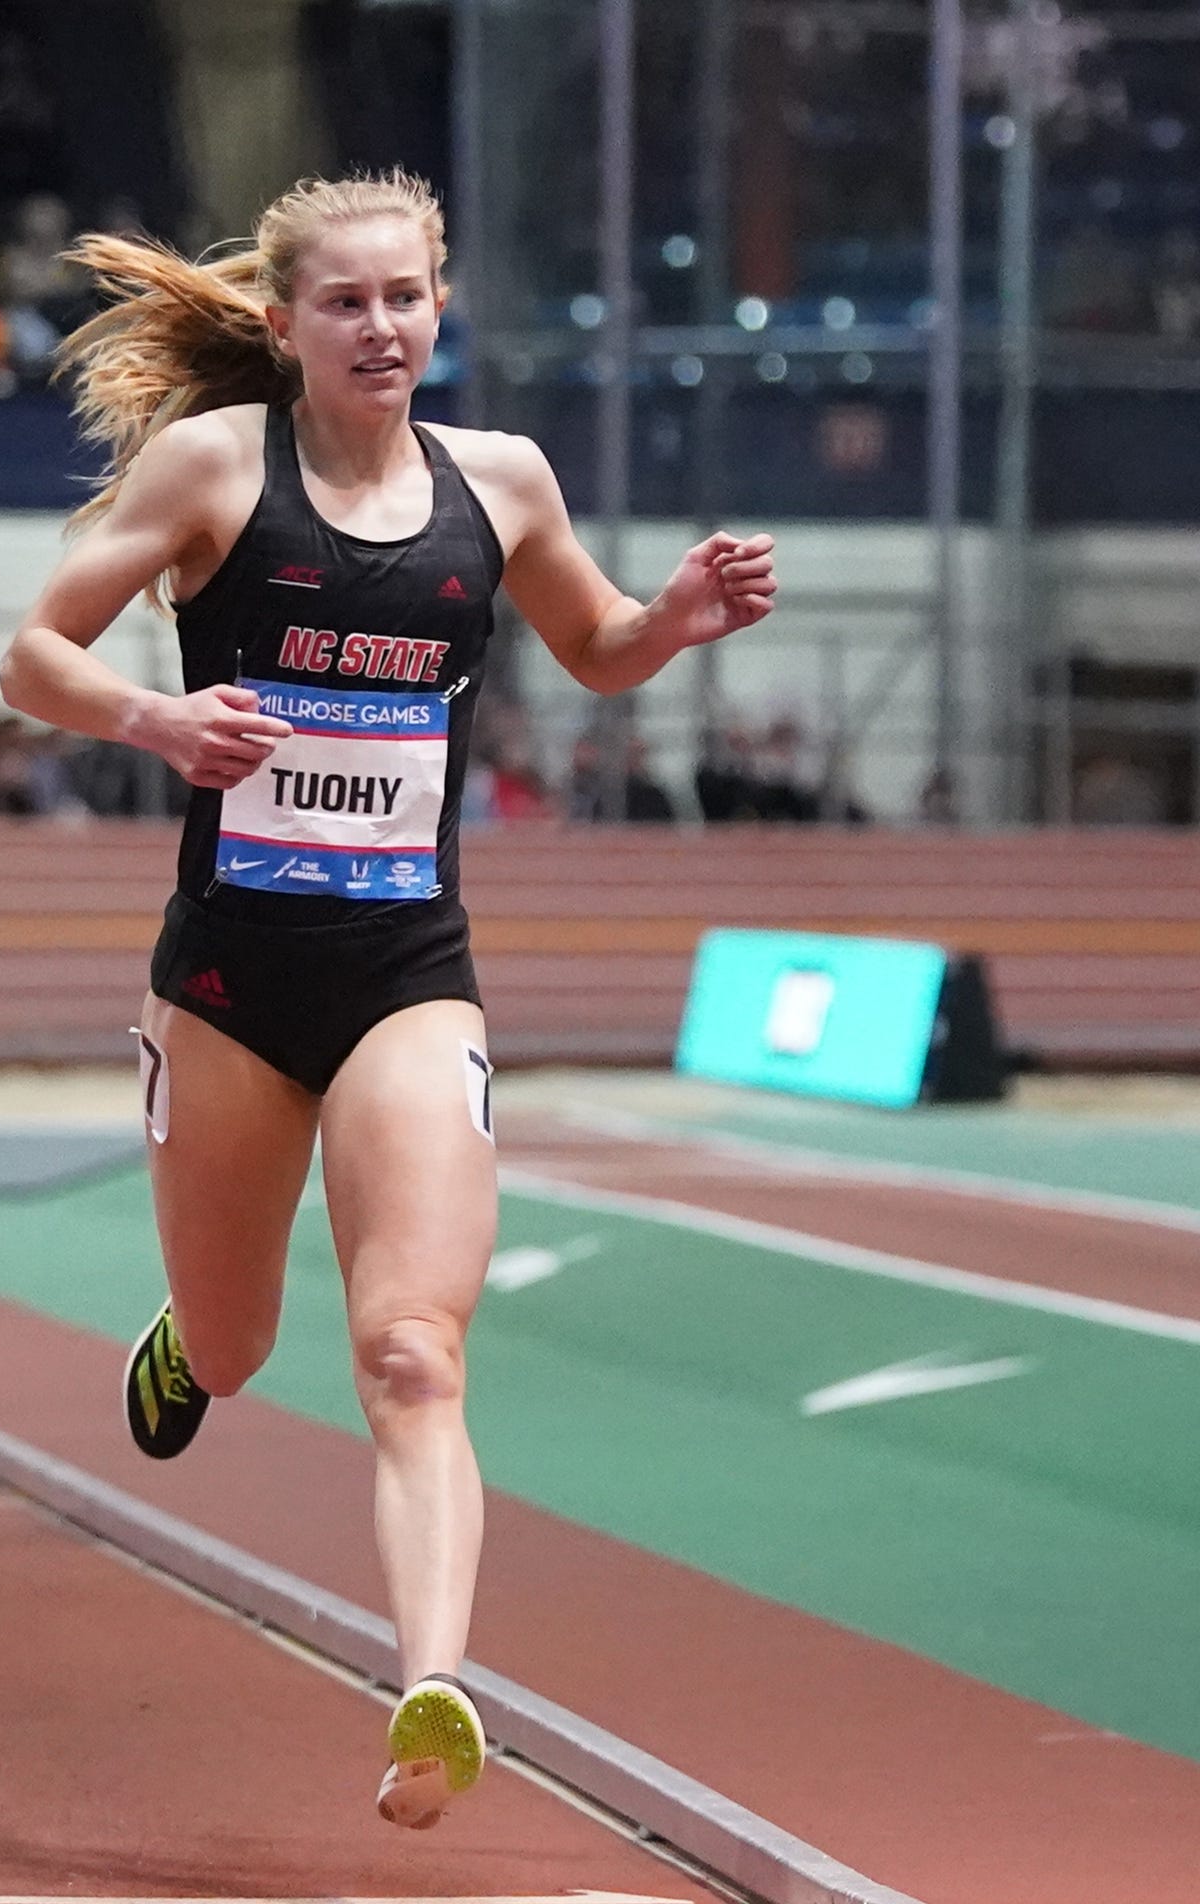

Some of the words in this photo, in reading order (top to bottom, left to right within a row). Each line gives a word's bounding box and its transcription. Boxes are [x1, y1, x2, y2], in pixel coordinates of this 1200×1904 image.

[278, 625, 338, 673] NC
[338, 632, 451, 684] STATE
[258, 694, 357, 724] MILLROSE
[360, 704, 431, 725] GAMES
[269, 766, 404, 816] TUOHY
[287, 870, 330, 883] ARMORY
[300, 860, 320, 872] THE
[140, 1032, 162, 1121] 7
